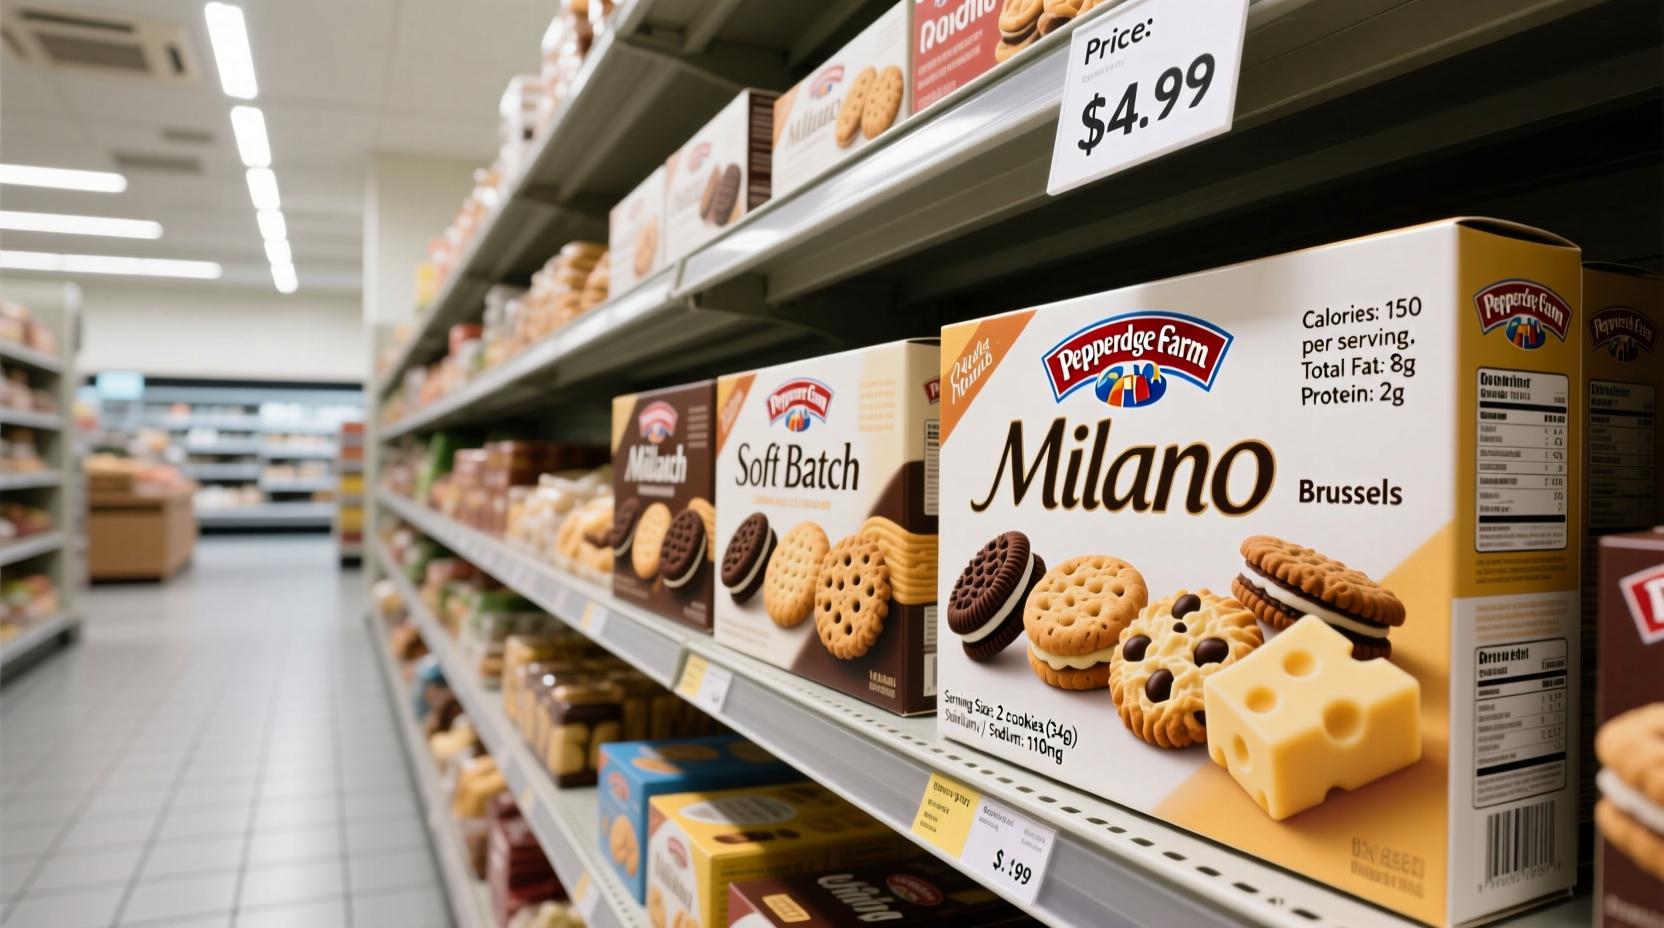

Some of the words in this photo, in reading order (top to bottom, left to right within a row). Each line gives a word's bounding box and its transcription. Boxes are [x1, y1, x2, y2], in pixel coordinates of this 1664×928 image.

[1084, 18, 1153, 65] Price:
[1078, 53, 1215, 156] $4.99
[1302, 304, 1379, 329] Calories:
[1385, 296, 1422, 319] 150
[1057, 324, 1156, 381] Pepperdge
[1157, 325, 1209, 369] Farm
[1302, 337, 1333, 359] per
[1301, 358, 1345, 380] Total
[1352, 357, 1385, 376] Fat:
[1390, 353, 1416, 378] 8g
[1301, 384, 1373, 406] Protein:
[1380, 381, 1405, 407] 2g
[735, 442, 780, 488] Soft
[784, 443, 860, 491] Batch
[970, 417, 1277, 517] Milano
[1298, 477, 1404, 506] Brussels
[996, 705, 1004, 721] 2
